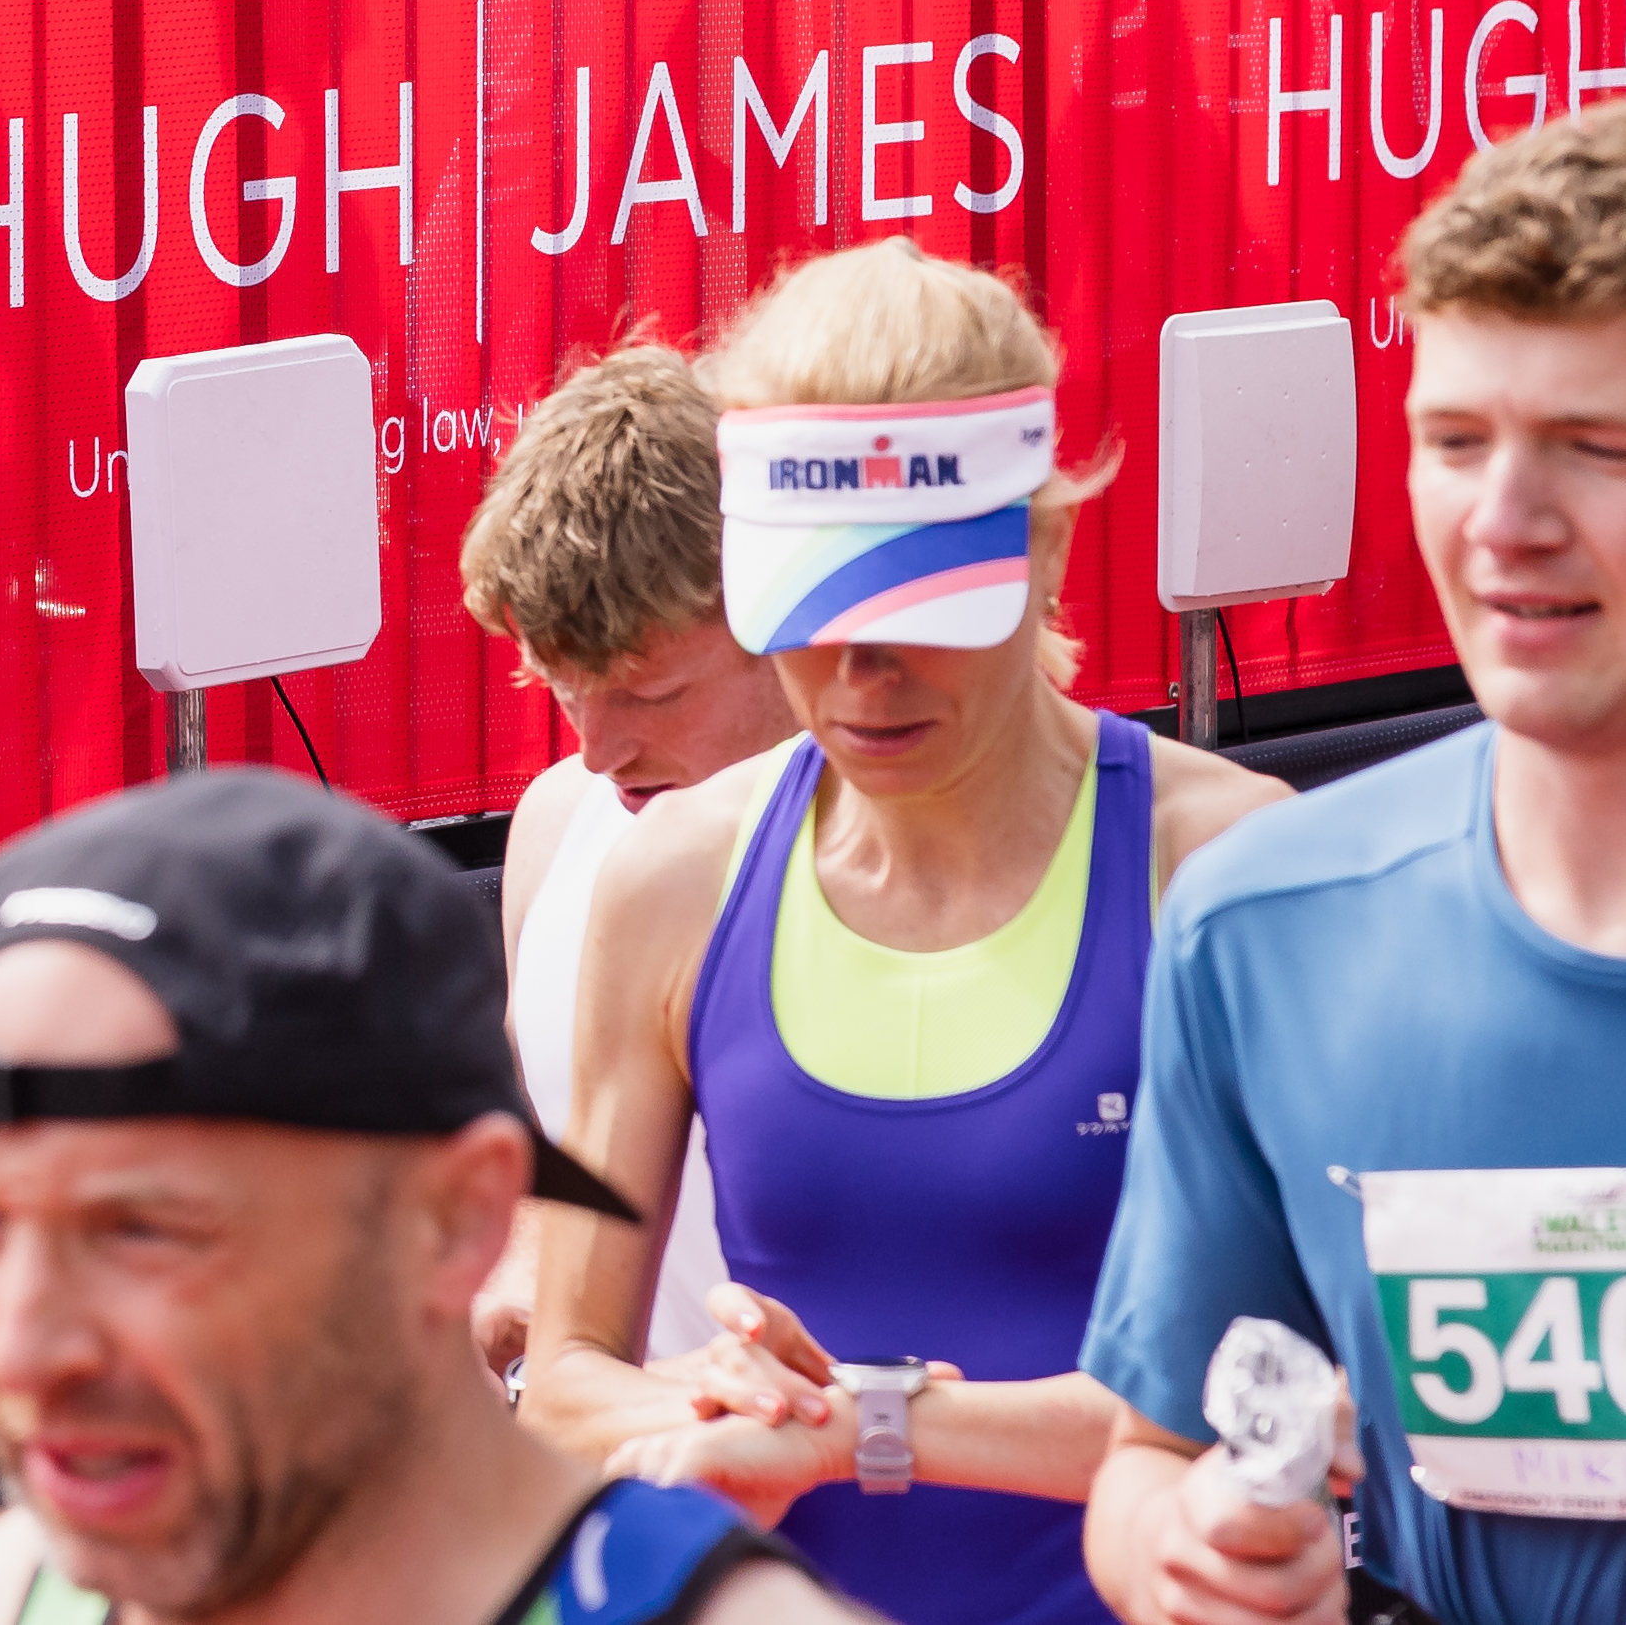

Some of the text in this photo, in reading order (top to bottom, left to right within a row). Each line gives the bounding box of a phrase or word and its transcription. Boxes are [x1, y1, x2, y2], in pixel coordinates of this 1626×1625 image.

[532, 34, 1025, 256] JAMES
[423, 397, 501, 457] law,
[769, 436, 962, 491] IRONMAN
[1408, 1276, 1626, 1425] 54
